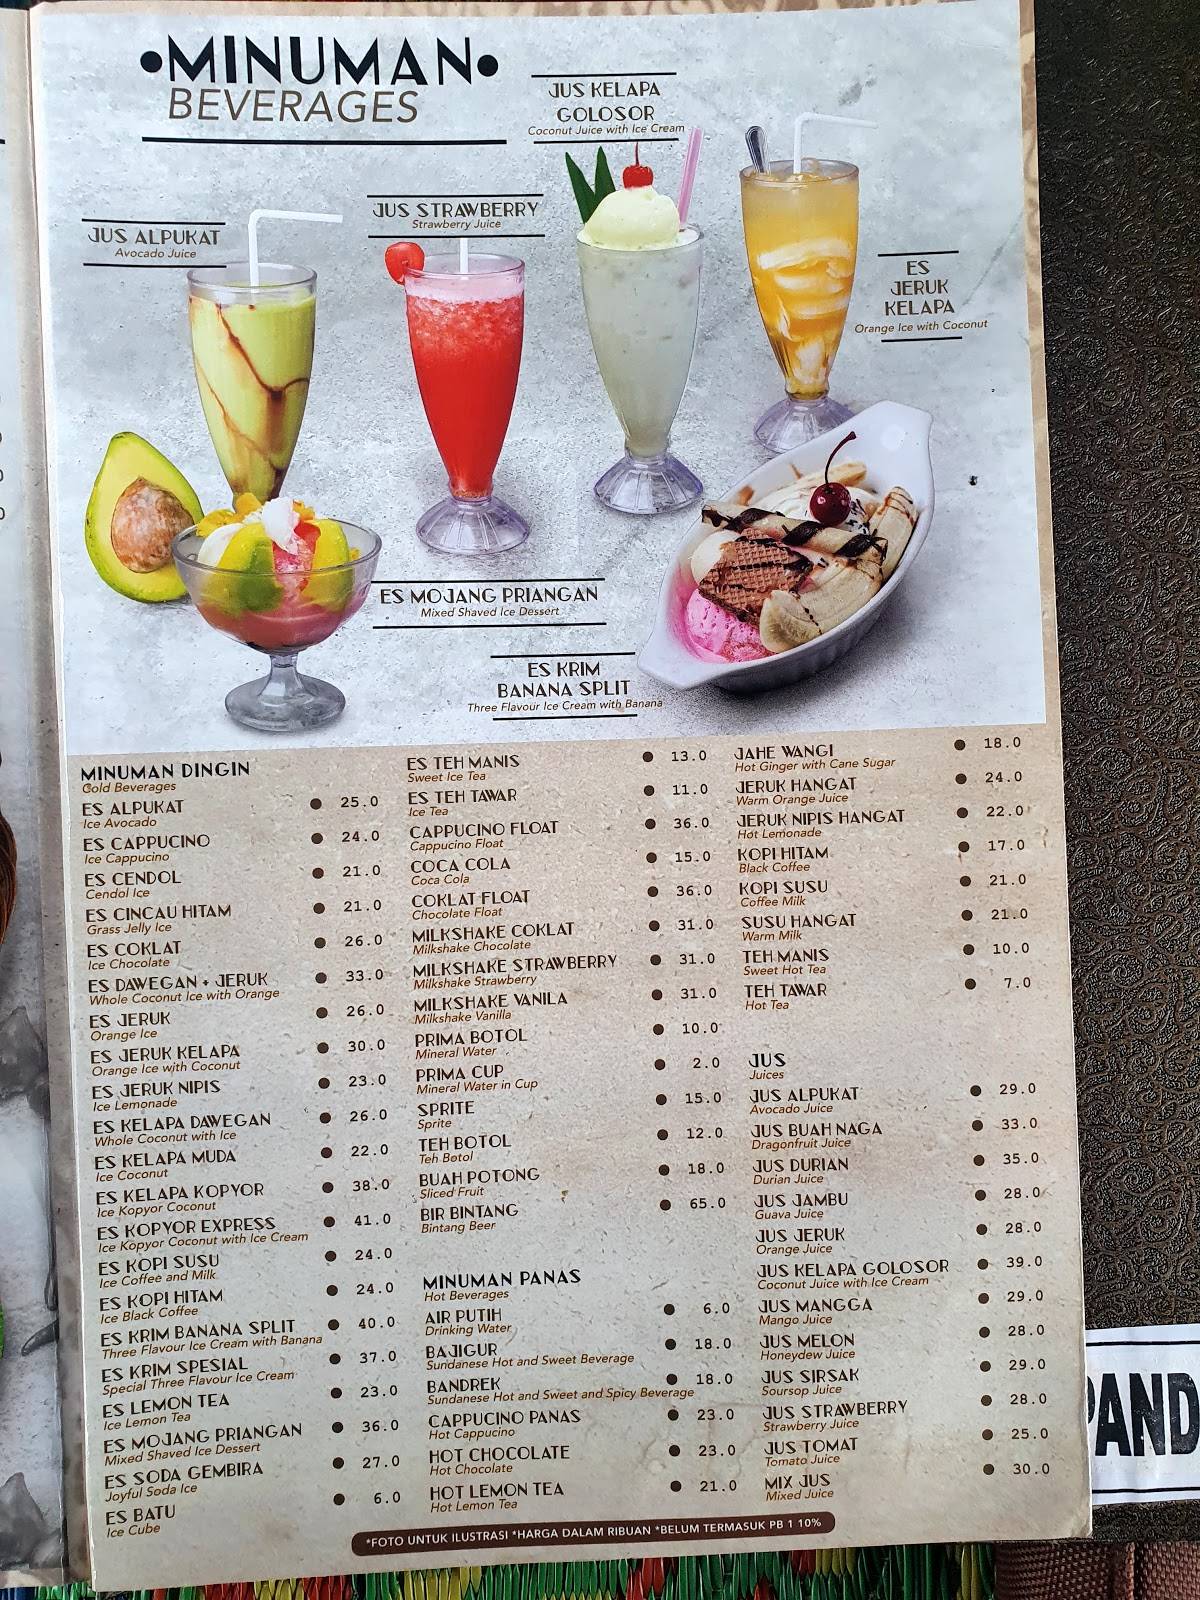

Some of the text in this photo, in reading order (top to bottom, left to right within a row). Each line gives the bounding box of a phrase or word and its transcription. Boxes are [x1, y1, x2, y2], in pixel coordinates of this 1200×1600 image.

[549, 82, 661, 98] JUS KELAPA
[168, 88, 419, 123] BEVERAGES
[557, 107, 654, 123] GOLOSOR
[528, 123, 685, 136] Coconut Juice with Ice Cream
[373, 202, 539, 218] JUS STRAWBERRY
[412, 219, 501, 231] Strawberry Juice
[88, 228, 220, 246] JUS ALPUKAT
[115, 248, 196, 259] Avocado Juice
[907, 261, 929, 275] ES
[890, 280, 949, 296] JERUK
[884, 300, 955, 316] KELAPA
[855, 320, 988, 335] Orange Ice with Coconut
[380, 587, 598, 604] ES MOJANG PRIANGAN
[421, 606, 559, 617] Mixed Shaved Ice Dessert
[529, 662, 600, 678] ES KRIM
[498, 681, 630, 698] BANANA SPLIT
[468, 699, 663, 712] Three Flavour Ice Cream with Banana
[407, 755, 520, 771] ES TEH MANIS
[671, 751, 707, 762] 13.0
[81, 762, 250, 781] MINUMAN DINGIN
[408, 772, 486, 782] Sweet Ice Tea
[985, 771, 1022, 783] 24.0
[83, 782, 176, 793] Cold Beverages
[736, 777, 856, 794] JERUK HANGAT
[341, 796, 378, 808] 25.0
[736, 793, 848, 806] Warm Orange Juice
[83, 800, 184, 816] ES ALPUKAT
[83, 818, 157, 829] Ice Avocado
[677, 885, 712, 896] 36.0
[412, 890, 530, 907] COKLAT FLOAT
[344, 900, 381, 912] 21.0
[86, 905, 231, 922] ES CINCAU HITAM
[412, 907, 502, 920] Chocolate Float
[87, 923, 171, 935] Grass Jelly Ice
[993, 943, 1029, 955] 10.0
[744, 949, 829, 964] TEH MANIS
[744, 964, 826, 976] Sweet Hot Tea
[749, 1053, 786, 1068] JUS
[750, 1070, 784, 1080] Juices
[351, 1144, 388, 1157] 22.0
[95, 1150, 236, 1169] ES KELAPA MUDA
[753, 1158, 849, 1173] JUS DURIAN
[1003, 1153, 1039, 1165] 35.0
[96, 1169, 168, 1182] Ice Coconut
[753, 1173, 823, 1185] Durian Juice
[690, 1198, 726, 1209] 65.0
[421, 1204, 518, 1221] BIR BINTANG
[421, 1221, 496, 1233] Bintang Beer
[424, 1269, 581, 1290] MINUMAN PANAS
[356, 1282, 394, 1295] 24.0
[424, 1289, 509, 1301] Hot Beverages
[100, 1289, 223, 1311] ES KOPI HITAM
[1007, 1290, 1043, 1303] 29.0
[759, 1298, 872, 1313] JUS MANGGA
[101, 1306, 198, 1324] Ice Black Coffee
[759, 1314, 832, 1327] Mango Juice
[361, 1385, 397, 1398] 23.0
[103, 1394, 229, 1418] ES LEMON TEA
[103, 1412, 191, 1431] Ice Lemon Tea
[430, 1446, 570, 1463] HOT CHOCOLATE
[699, 1445, 735, 1457] 23.0
[430, 1463, 513, 1475] Hot Chocolate
[1013, 1463, 1050, 1475] 30.0
[765, 1474, 830, 1490] MIX JUS
[374, 1492, 400, 1504] 6.0
[766, 1489, 834, 1501] Mixed Juice
[106, 1505, 176, 1525] ES BATU
[107, 1524, 160, 1538] Ice Cube
[408, 1533, 448, 1545] UNTUK
[452, 1531, 508, 1543] ILUSTRASI
[562, 1527, 603, 1539] DALAM
[607, 1525, 650, 1537] RIBUAN
[704, 1520, 765, 1533] TERMASUK
[769, 1520, 783, 1529] PB
[788, 1520, 793, 1528] 1
[798, 1518, 821, 1528] 10%
